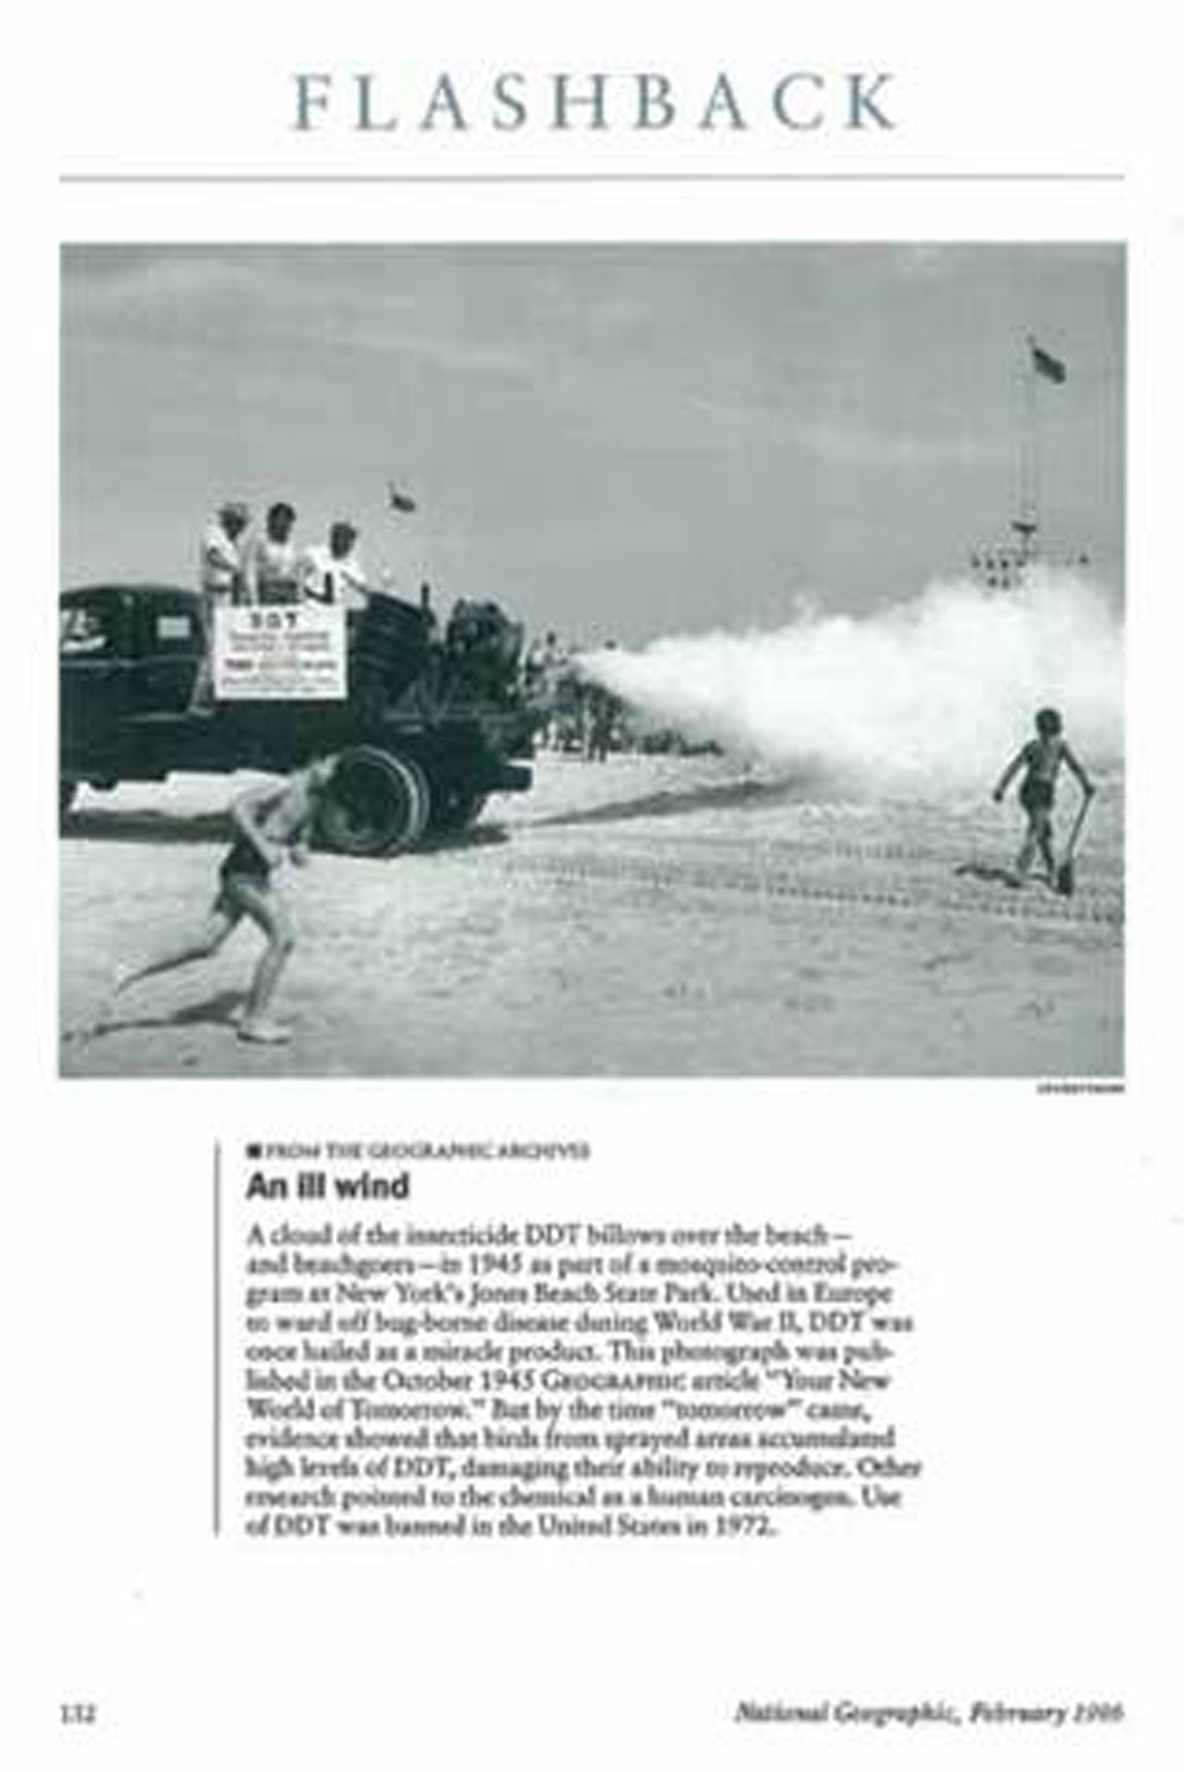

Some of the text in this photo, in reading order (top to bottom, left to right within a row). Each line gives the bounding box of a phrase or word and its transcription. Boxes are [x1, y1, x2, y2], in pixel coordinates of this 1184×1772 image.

[293, 74, 900, 130] FLASHBACK
[266, 1143, 590, 1159] FROM THE GEOGRAPHIC ARCHIVES
[246, 1171, 411, 1200] An ill wind
[246, 1224, 265, 1245] A
[271, 1224, 332, 1245] cloud
[338, 1223, 364, 1245] of
[367, 1224, 399, 1245] the
[407, 1224, 518, 1245] insecticide
[526, 1224, 581, 1245] DDT
[588, 1224, 665, 1245] billows
[672, 1231, 719, 1245] over
[725, 1224, 759, 1245] the
[246, 1252, 288, 1275] and
[470, 1253, 522, 1275] 1945
[530, 1259, 552, 1275] as
[558, 1258, 603, 1278] part
[609, 1252, 633, 1274] of
[639, 1259, 650, 1274] a
[245, 1287, 303, 1307] gram
[309, 1287, 330, 1303] at
[336, 1282, 387, 1303] New
[469, 1282, 528, 1307] Jones
[534, 1282, 600, 1303] Beach
[604, 1282, 658, 1303] State
[665, 1282, 720, 1303] Park.
[726, 1281, 780, 1303] Used
[786, 1285, 808, 1303] in
[814, 1282, 892, 1307] Europe
[246, 1317, 269, 1332] to
[276, 1311, 332, 1332] ward
[337, 1309, 370, 1332] off
[493, 1310, 570, 1332] disease
[574, 1311, 648, 1336] during
[653, 1309, 722, 1332] World
[728, 1310, 772, 1332] War
[779, 1310, 803, 1334] II,
[809, 1310, 865, 1332] DDT
[872, 1318, 913, 1332] was
[245, 1346, 297, 1362] once
[303, 1339, 370, 1362] hailed
[376, 1347, 398, 1361] as
[405, 1347, 417, 1361] a
[423, 1340, 503, 1362] miracle
[509, 1339, 601, 1365] product.
[607, 1339, 655, 1361] This
[661, 1339, 790, 1365] photograph
[795, 1346, 838, 1361] was
[246, 1368, 310, 1392] lished
[315, 1375, 337, 1391] in
[342, 1368, 377, 1391] the
[382, 1368, 473, 1391] October
[481, 1367, 535, 1391] 1945
[541, 1368, 686, 1392] GEOGRAPHIC
[692, 1367, 759, 1392] article
[839, 1369, 890, 1390] New
[247, 1397, 315, 1420] World
[320, 1398, 345, 1419] of
[492, 1398, 529, 1420] But
[536, 1397, 562, 1423] by
[569, 1397, 603, 1419] the
[608, 1404, 655, 1420] time
[806, 1404, 871, 1423] came,
[245, 1426, 895, 1452] evidence showed that birds from sprayed areas accumulated
[245, 1454, 922, 1481] high levels of DDT, damaging their ability to reproduce. Other
[245, 1483, 901, 1510] research pointed to the chemical as a human carcinogen. Use
[245, 1513, 776, 1537] of DDT was banned in the United States in 1972.
[735, 1701, 829, 1722] National
[833, 1700, 962, 1728] Geographic,
[969, 1701, 1067, 1727] February
